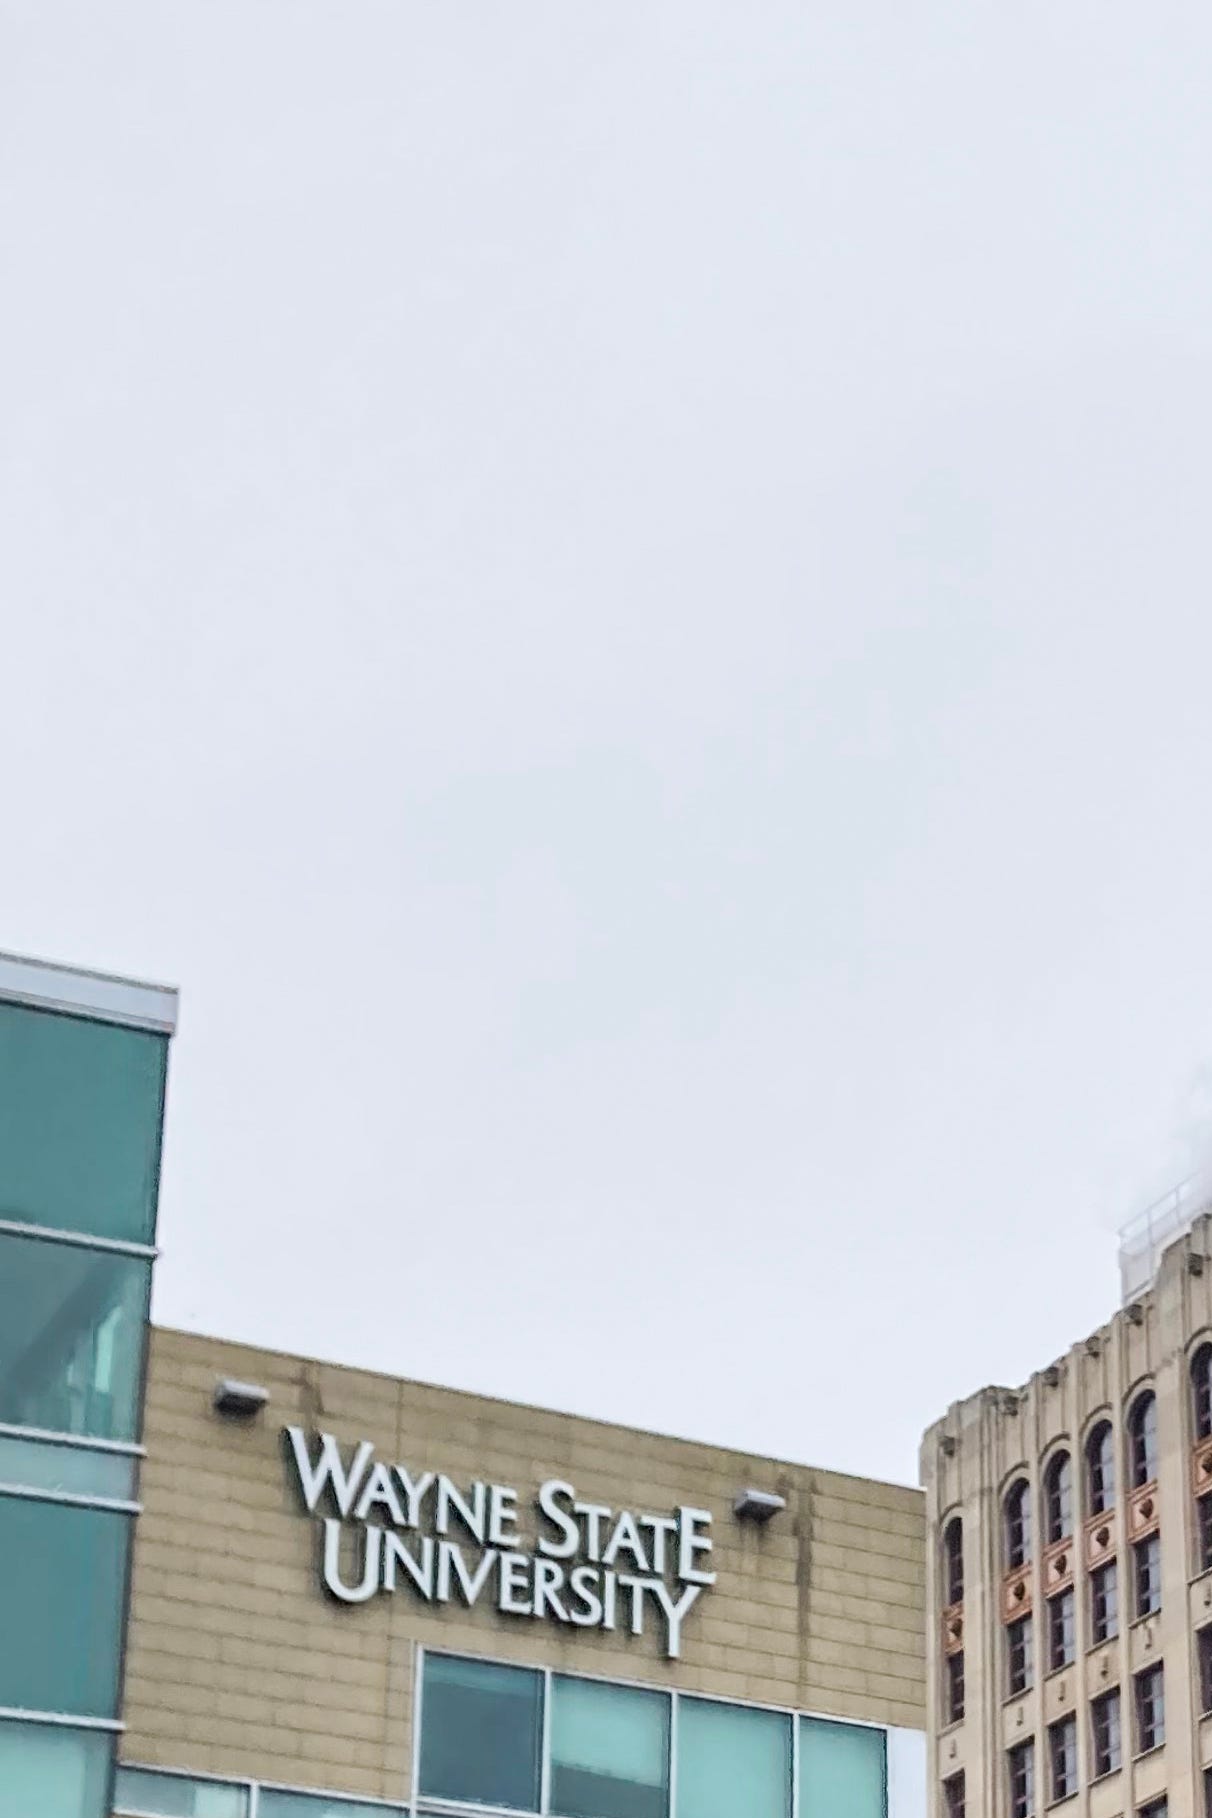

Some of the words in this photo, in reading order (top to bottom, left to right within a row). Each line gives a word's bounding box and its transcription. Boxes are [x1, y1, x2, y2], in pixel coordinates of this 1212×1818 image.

[285, 1425, 521, 1547] WAYNE
[537, 1479, 717, 1586] STATE
[323, 1518, 700, 1659] UNIVERSITY
